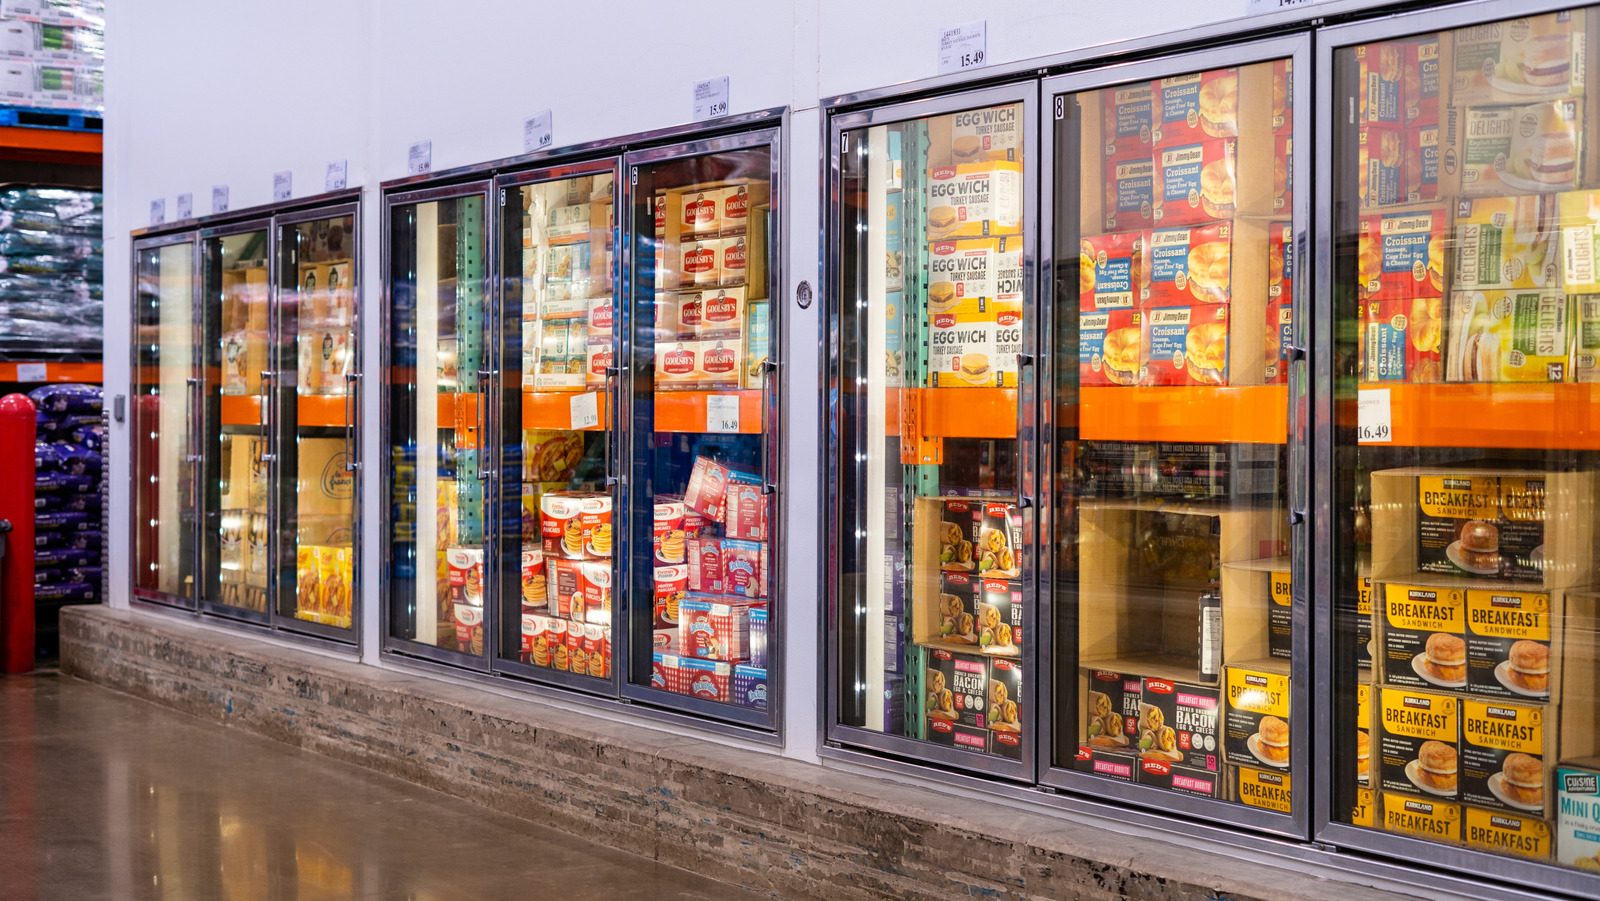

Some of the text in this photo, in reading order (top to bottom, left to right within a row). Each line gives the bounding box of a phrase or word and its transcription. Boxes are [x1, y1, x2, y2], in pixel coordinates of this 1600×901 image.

[961, 51, 983, 67] 15.49
[1165, 86, 1197, 98] Croissant
[710, 102, 726, 115] 15.99
[1056, 97, 1063, 118] 8
[1119, 104, 1150, 114] Croissant
[976, 122, 1015, 135] TURKEY SAUSAGE
[1470, 119, 1511, 135] DELIGHTS
[842, 133, 847, 152] 7
[1166, 165, 1198, 178] Croissant
[1120, 179, 1151, 189] Croissant
[969, 194, 989, 204] SAUSAGE
[687, 205, 714, 217] GOOLSBY'S
[1398, 219, 1428, 230] Jimmy Dean
[1385, 235, 1426, 246] Croissant
[1153, 248, 1186, 258] Croissant
[1463, 226, 1477, 282] DELIGHTS
[1575, 229, 1591, 280] DELIGHTS
[686, 255, 713, 264] GOOLSBY'S
[950, 271, 986, 281] TURKEY SAUSAGE
[1098, 281, 1128, 290] Croissant
[707, 303, 735, 314] GOOLSBY'S
[935, 317, 955, 326] RED'S
[1540, 296, 1555, 354] DELIGHTS
[1153, 327, 1185, 336] Croissant
[947, 345, 963, 355] SAUSAGE
[996, 345, 1010, 354] TURKEY
[665, 356, 693, 366] GOOLSBY'S
[705, 355, 733, 365] GOOLSBY'S
[1552, 365, 1561, 379] 12
[722, 420, 737, 430] 16.49
[1358, 425, 1388, 439] 16.49
[1443, 479, 1471, 488] KIRKLAND
[1425, 491, 1489, 509] BREAKFAST
[1437, 507, 1478, 516] SANDWICH
[1492, 596, 1521, 605] KIRKLAND
[1391, 603, 1455, 621] BREAKFAST
[1402, 618, 1443, 629] SANDWICH
[1472, 609, 1539, 628] BREAKFAST
[1484, 625, 1527, 636] SANDWICH
[953, 674, 984, 691] BACON
[1148, 680, 1173, 693] RED'S
[1178, 695, 1215, 707] BREAKFAST BURRITO
[1404, 698, 1430, 707] KIRKLAND
[1487, 708, 1516, 717] KIRKLAND
[1176, 711, 1215, 728] BACON
[1386, 709, 1447, 730] BREAKFAST
[1396, 724, 1436, 737] SANDWICH
[1467, 718, 1535, 742] BREAKFAST
[998, 734, 1017, 743] RED'S
[1479, 736, 1522, 749] SANDWICH
[1095, 761, 1130, 775] BREAKFAST BURRITO
[1144, 761, 1168, 772] RED'S
[1174, 776, 1211, 790] BREAKFAST BURRITO
[1253, 798, 1288, 811] SANDWICH
[1405, 801, 1433, 811] KIRKLAND
[1561, 797, 1588, 818] MINI
[1389, 811, 1450, 835] BREAKFAST
[1491, 816, 1520, 827] KIRKLAND
[1575, 821, 1588, 831] flaky
[1471, 827, 1540, 852] BREAKFAST
